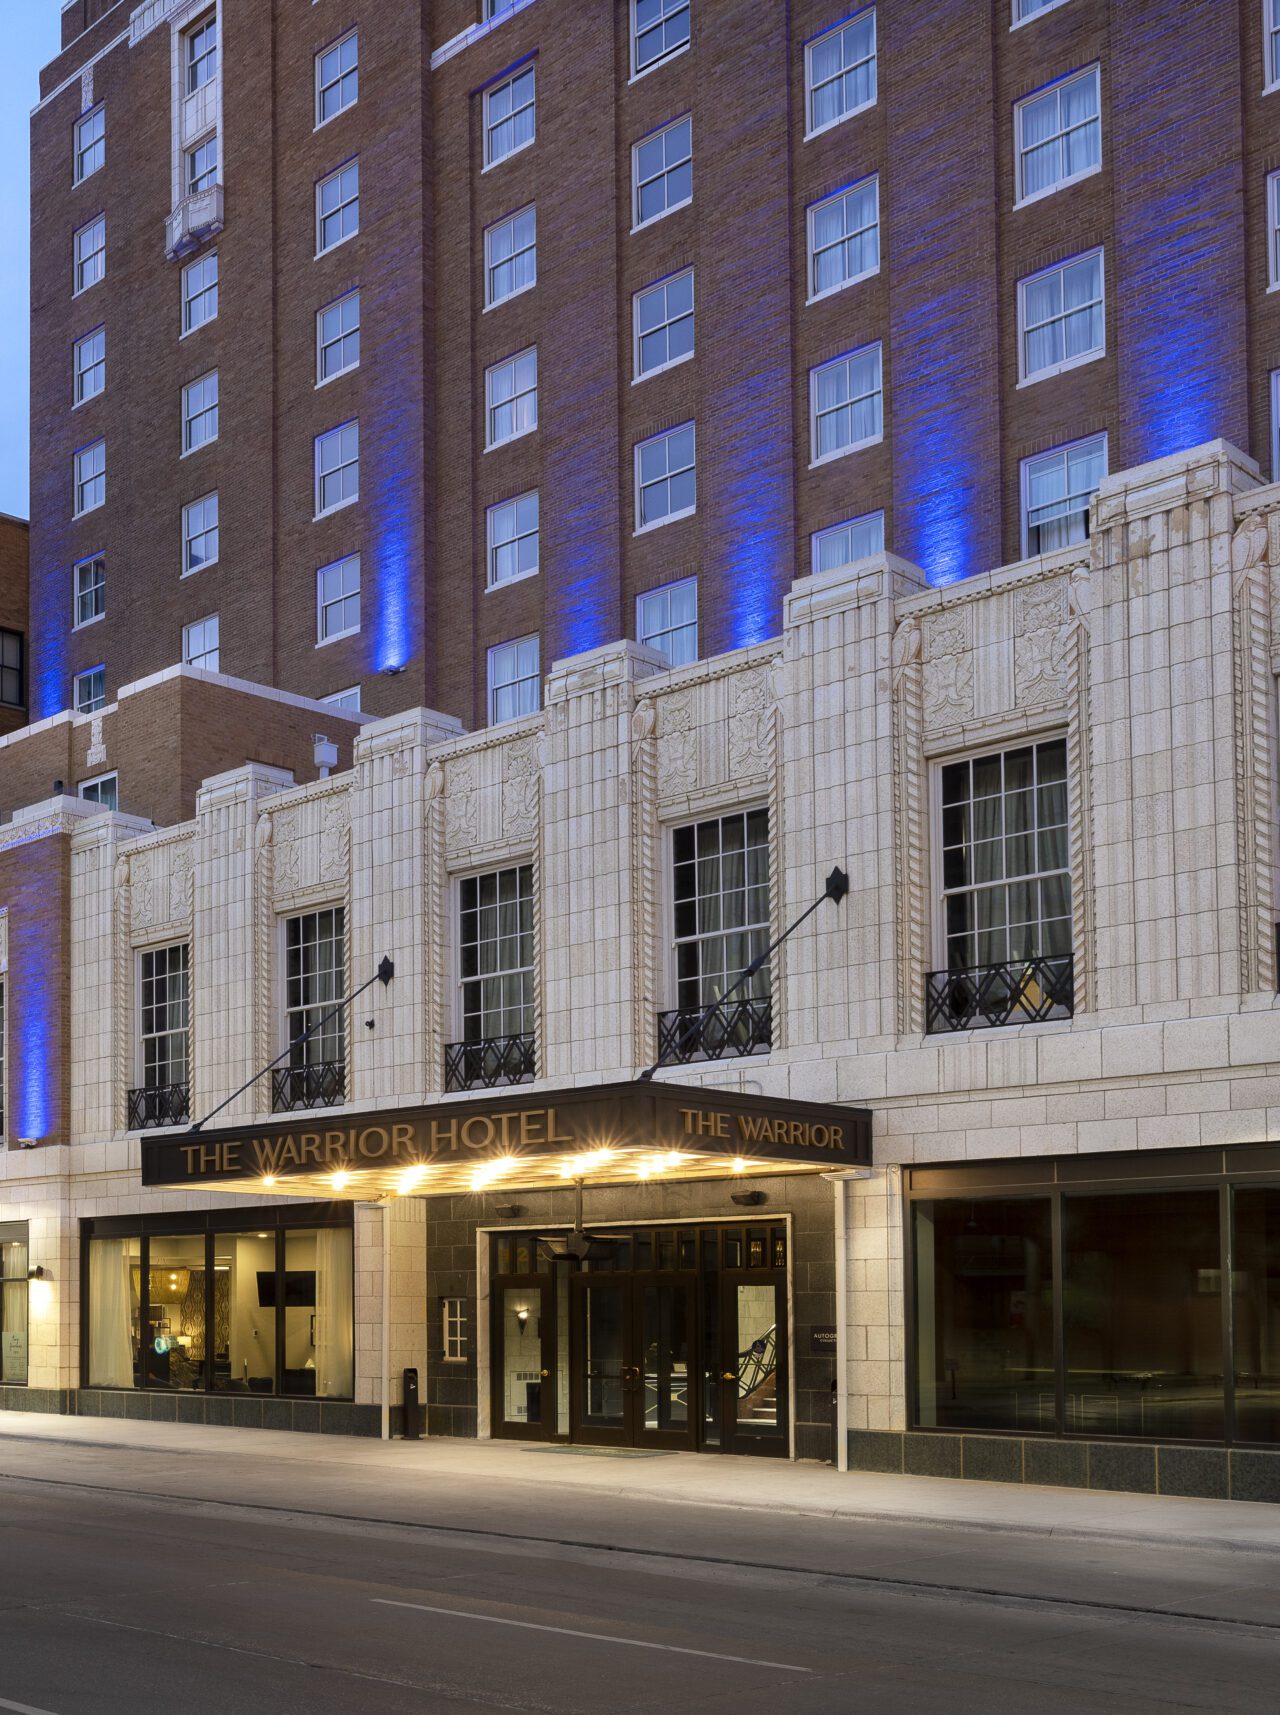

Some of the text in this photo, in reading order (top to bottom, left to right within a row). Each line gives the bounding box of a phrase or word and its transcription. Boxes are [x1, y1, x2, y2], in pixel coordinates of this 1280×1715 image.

[180, 1108, 574, 1174] THE WARRIOR HOTEL
[679, 1108, 845, 1150] THE WARRIOR
